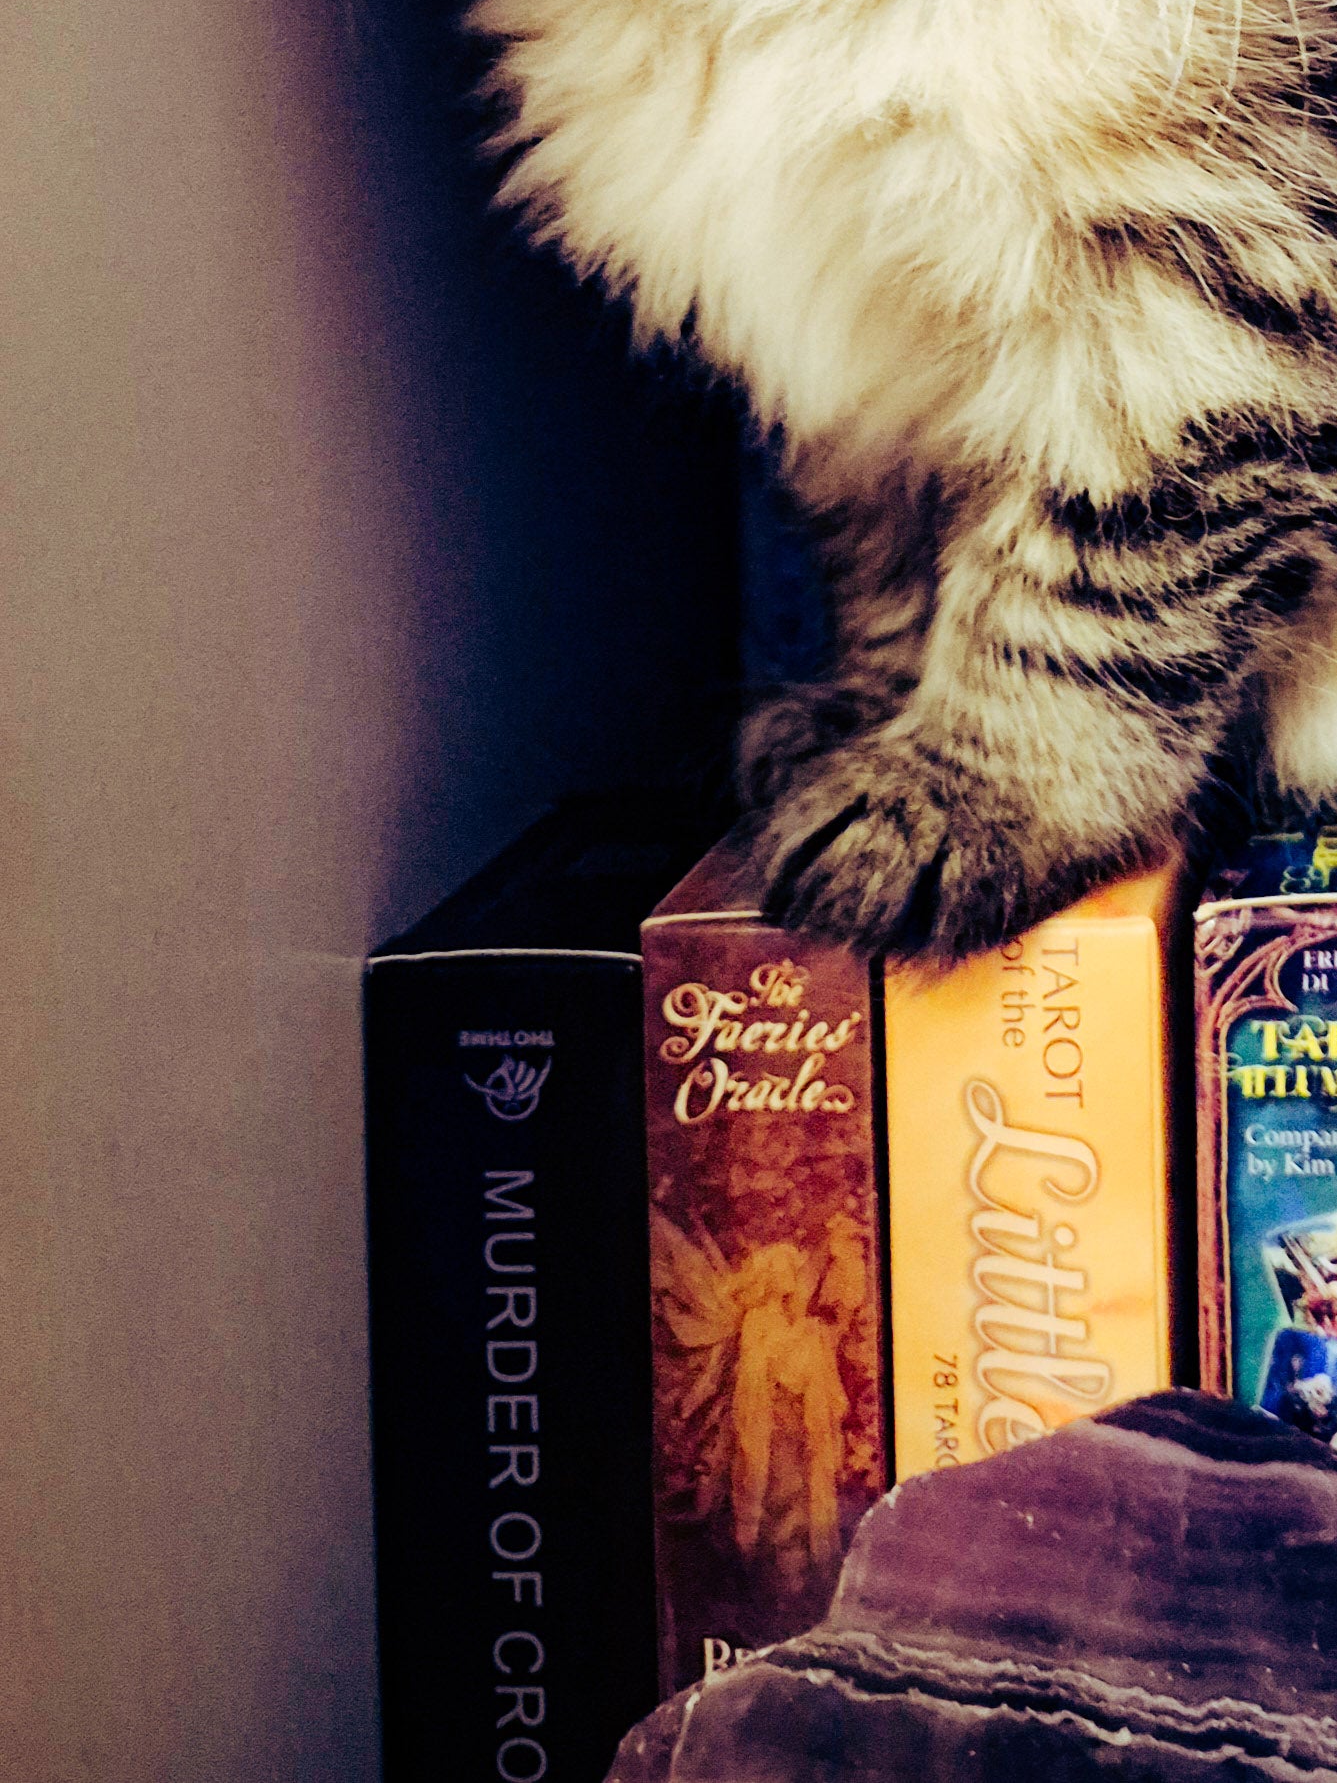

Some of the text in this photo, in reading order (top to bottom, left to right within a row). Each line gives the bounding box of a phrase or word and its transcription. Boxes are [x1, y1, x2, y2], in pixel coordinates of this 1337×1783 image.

[750, 958, 810, 1007] The
[1000, 938, 1037, 1048] of the
[1041, 937, 1084, 1108] TAROT
[674, 1052, 855, 1125] Oracle
[1248, 1151, 1276, 1182] by
[1284, 1152, 1336, 1176] Kim
[965, 1079, 1111, 1455] Little
[933, 1353, 959, 1389] 78
[483, 1170, 547, 1783] MURDER OF CRO
